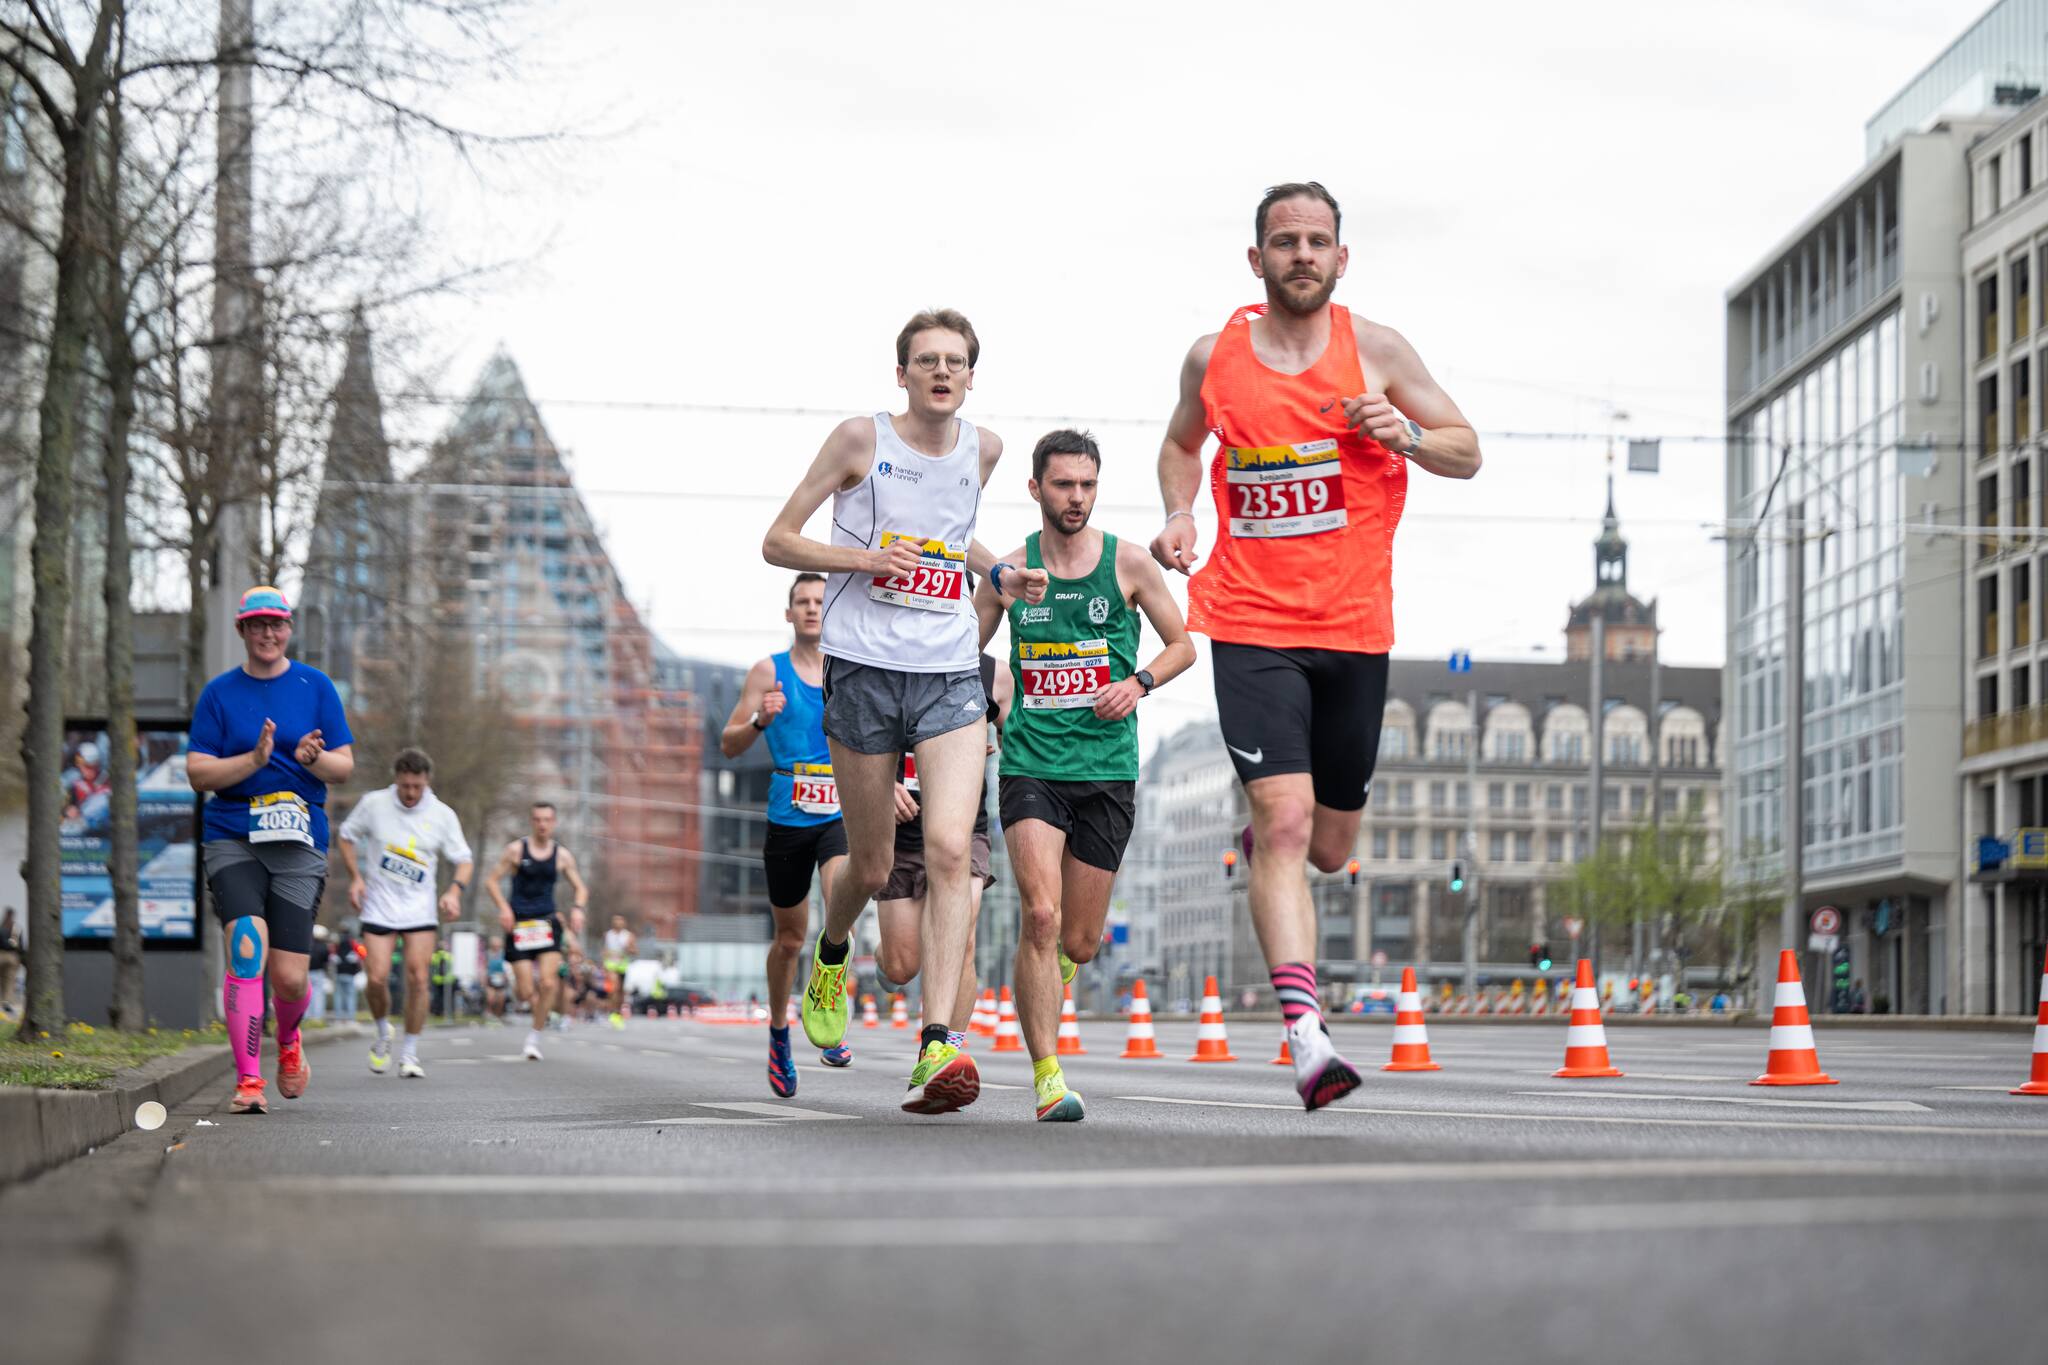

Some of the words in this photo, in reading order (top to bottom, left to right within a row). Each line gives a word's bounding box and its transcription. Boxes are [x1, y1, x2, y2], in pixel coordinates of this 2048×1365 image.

[895, 466, 923, 478] hamburg
[1259, 472, 1294, 482] Benjamin
[893, 473, 919, 484] running
[1237, 479, 1329, 518] 23519
[912, 596, 934, 605] Leipziger
[1044, 661, 1081, 669] Halbmarathon
[1031, 668, 1098, 695] 24993
